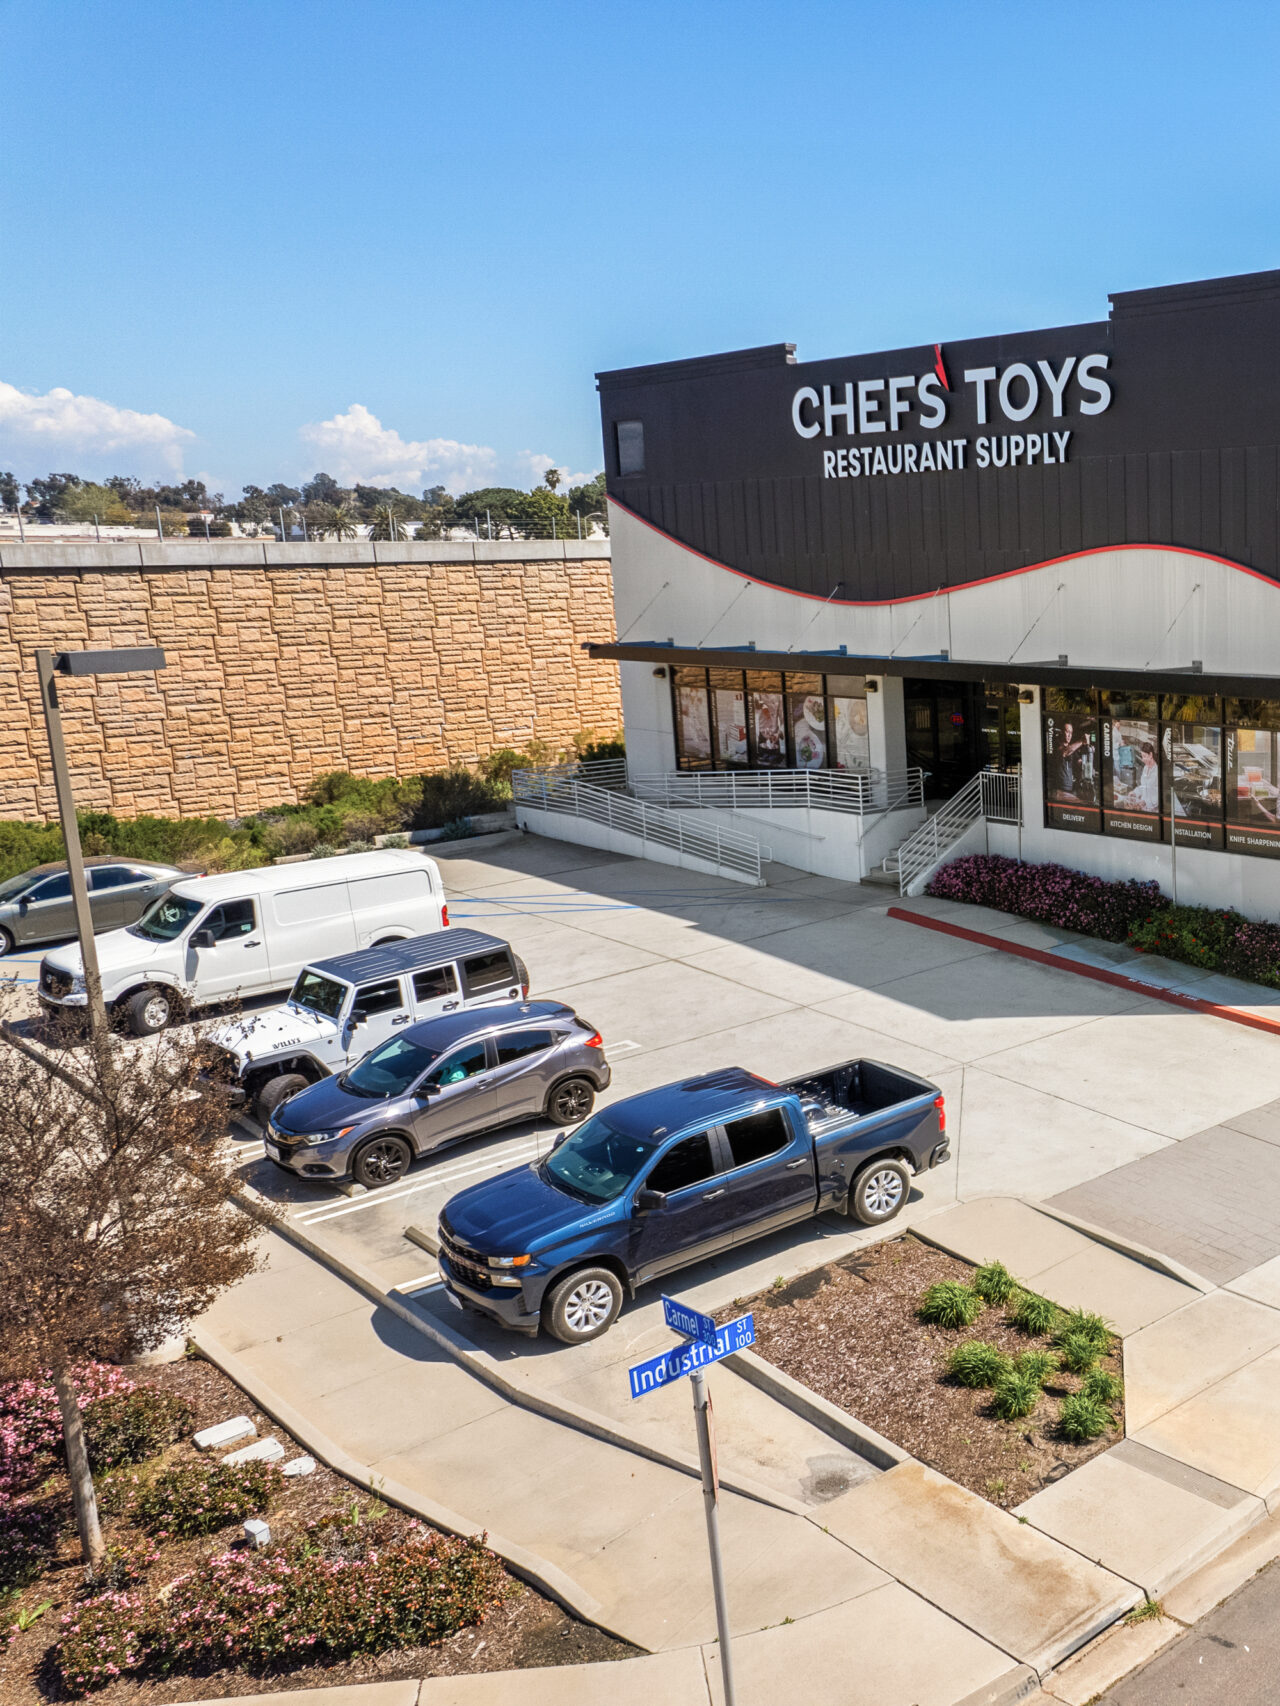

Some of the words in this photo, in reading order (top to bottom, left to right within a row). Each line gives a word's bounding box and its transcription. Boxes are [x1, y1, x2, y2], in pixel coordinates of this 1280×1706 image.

[964, 354, 1112, 424] TOYS
[823, 439, 967, 479] RESTAURANT
[976, 430, 1072, 469] SUPPLY
[1103, 722, 1111, 757] CAMBRO
[1062, 813, 1085, 823] DELIVERY
[1110, 820, 1132, 830] KITCHEN
[1133, 823, 1153, 832] DESIGN
[1174, 828, 1212, 839] NSTALLATION
[1229, 835, 1246, 844] KNIFE
[272, 1037, 302, 1050] WILLYS
[665, 1301, 700, 1336] Carmel
[703, 1317, 711, 1330] ST
[735, 1332, 752, 1347] 100
[633, 1330, 731, 1394] Industrial
[736, 1318, 748, 1334] ST
